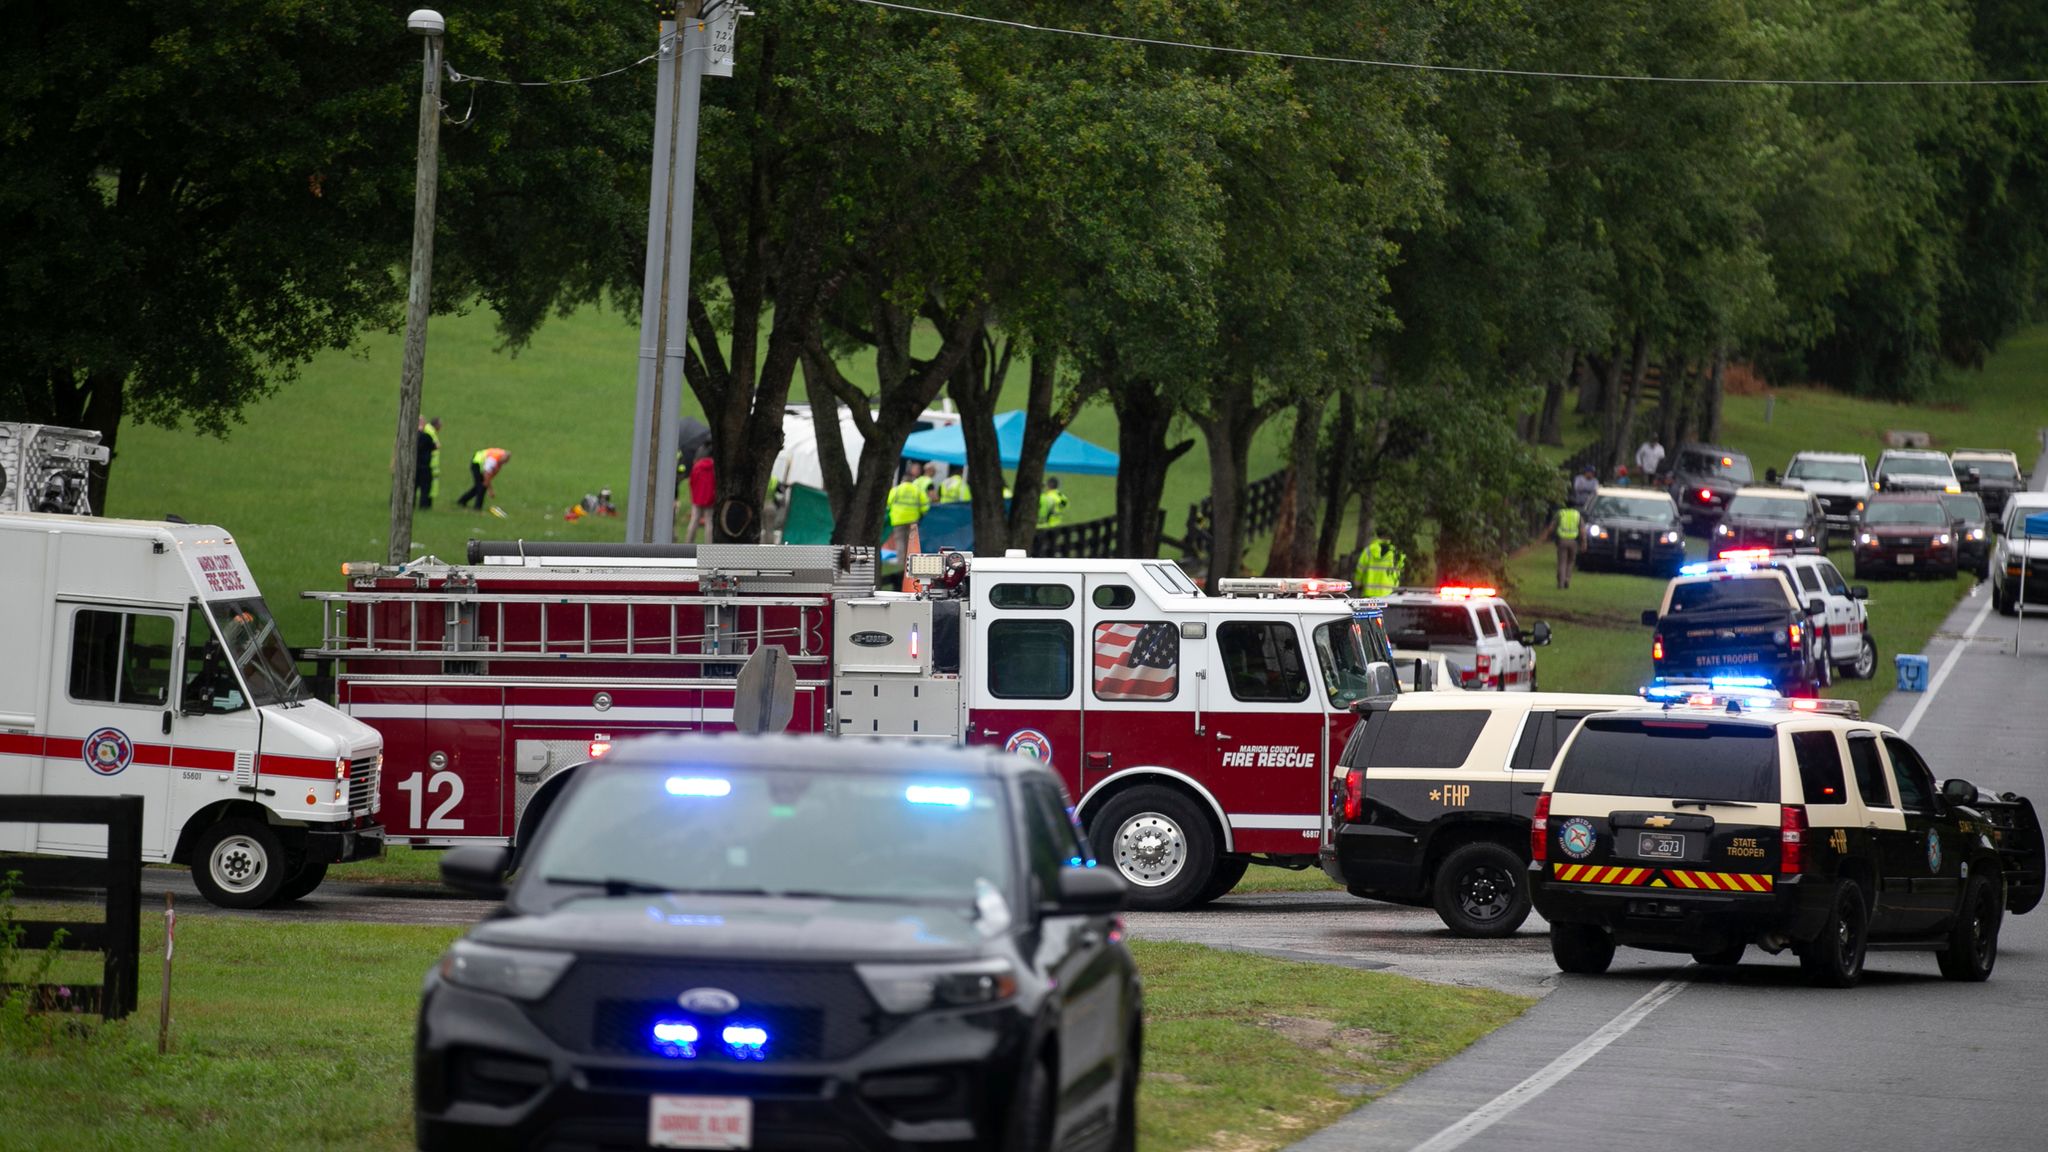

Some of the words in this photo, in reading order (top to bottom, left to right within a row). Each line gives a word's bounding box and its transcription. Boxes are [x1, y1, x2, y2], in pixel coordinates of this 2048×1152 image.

[1696, 655, 1721, 666] STATE
[1723, 653, 1759, 664] TROOPER
[1239, 745, 1268, 753] MARION
[1269, 745, 1299, 753] COUNTY
[1222, 752, 1255, 767] FIRE
[1257, 753, 1316, 768] RESCUE
[182, 771, 202, 781] 55601
[398, 771, 465, 830] 12
[1563, 817, 1593, 830] FLORIDA
[1658, 840, 1680, 853] 2673
[1732, 837, 1757, 848] STATE
[1727, 848, 1765, 858] TROOPER
